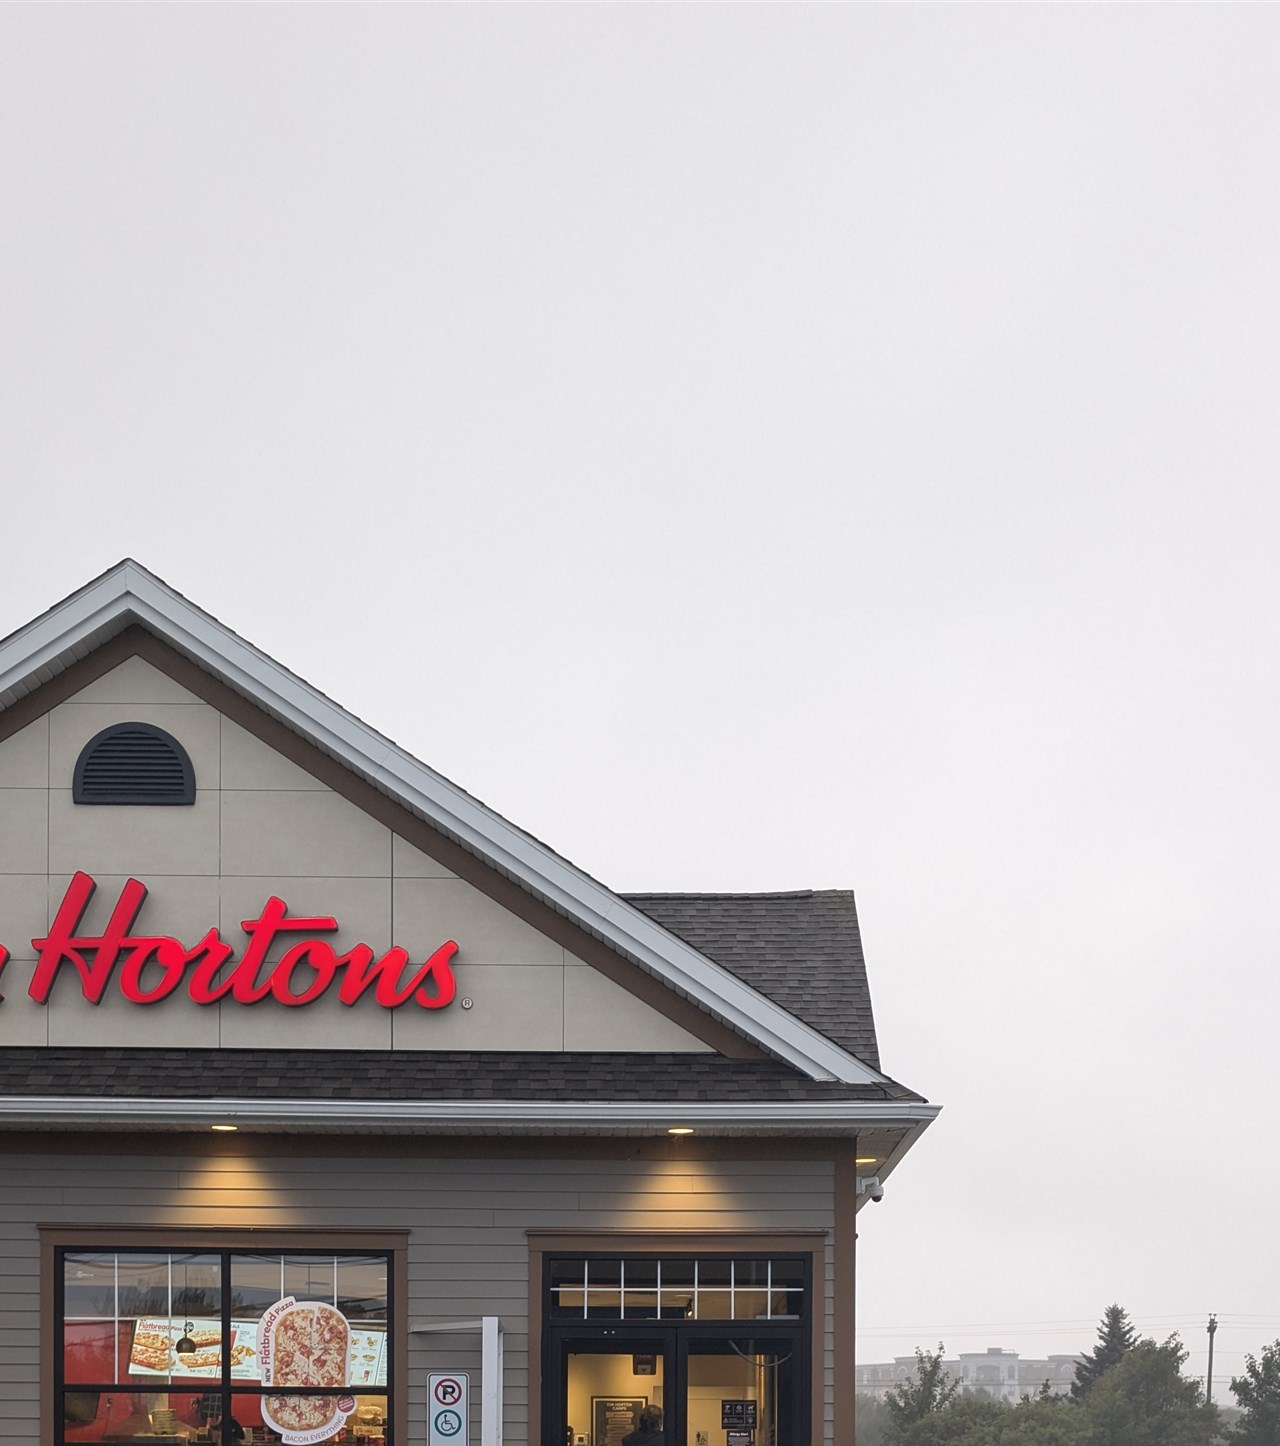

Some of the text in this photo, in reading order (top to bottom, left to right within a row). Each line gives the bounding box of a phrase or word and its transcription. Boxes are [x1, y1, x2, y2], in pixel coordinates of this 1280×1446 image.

[28, 870, 460, 1009] Hortons
[259, 1311, 277, 1365] Flatbread
[274, 1300, 295, 1316] Pizza
[284, 1434, 309, 1443] BACON
[309, 1415, 345, 1441] EVERYTHING
